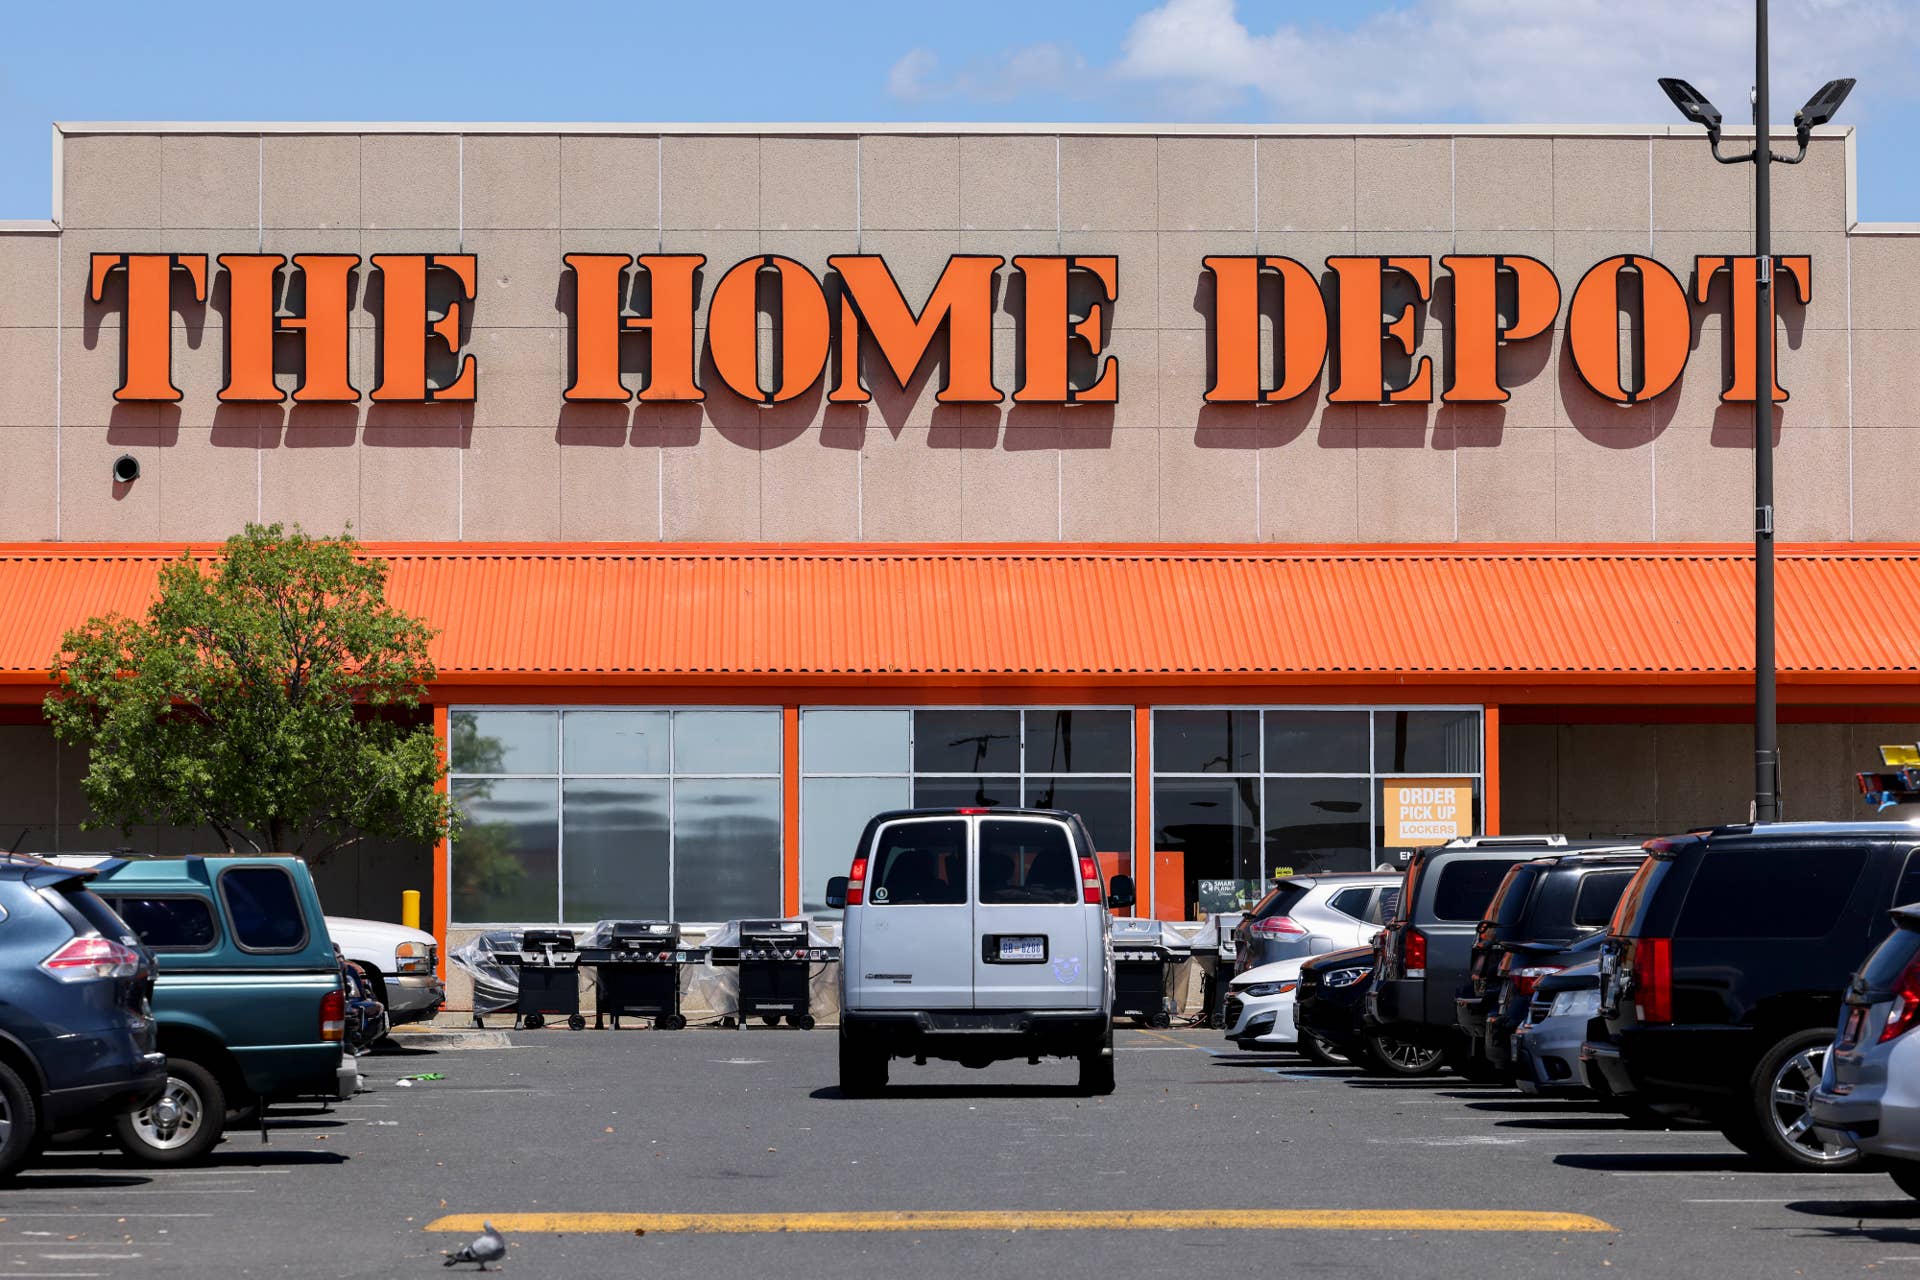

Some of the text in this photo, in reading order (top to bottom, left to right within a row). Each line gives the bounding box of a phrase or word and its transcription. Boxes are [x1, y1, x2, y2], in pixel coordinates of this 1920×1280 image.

[90, 253, 1812, 404] THE HOME DEPOT
[1400, 787, 1455, 804] ORDER
[1400, 806, 1456, 820] PICK UP
[1402, 825, 1455, 834] LOCKERS
